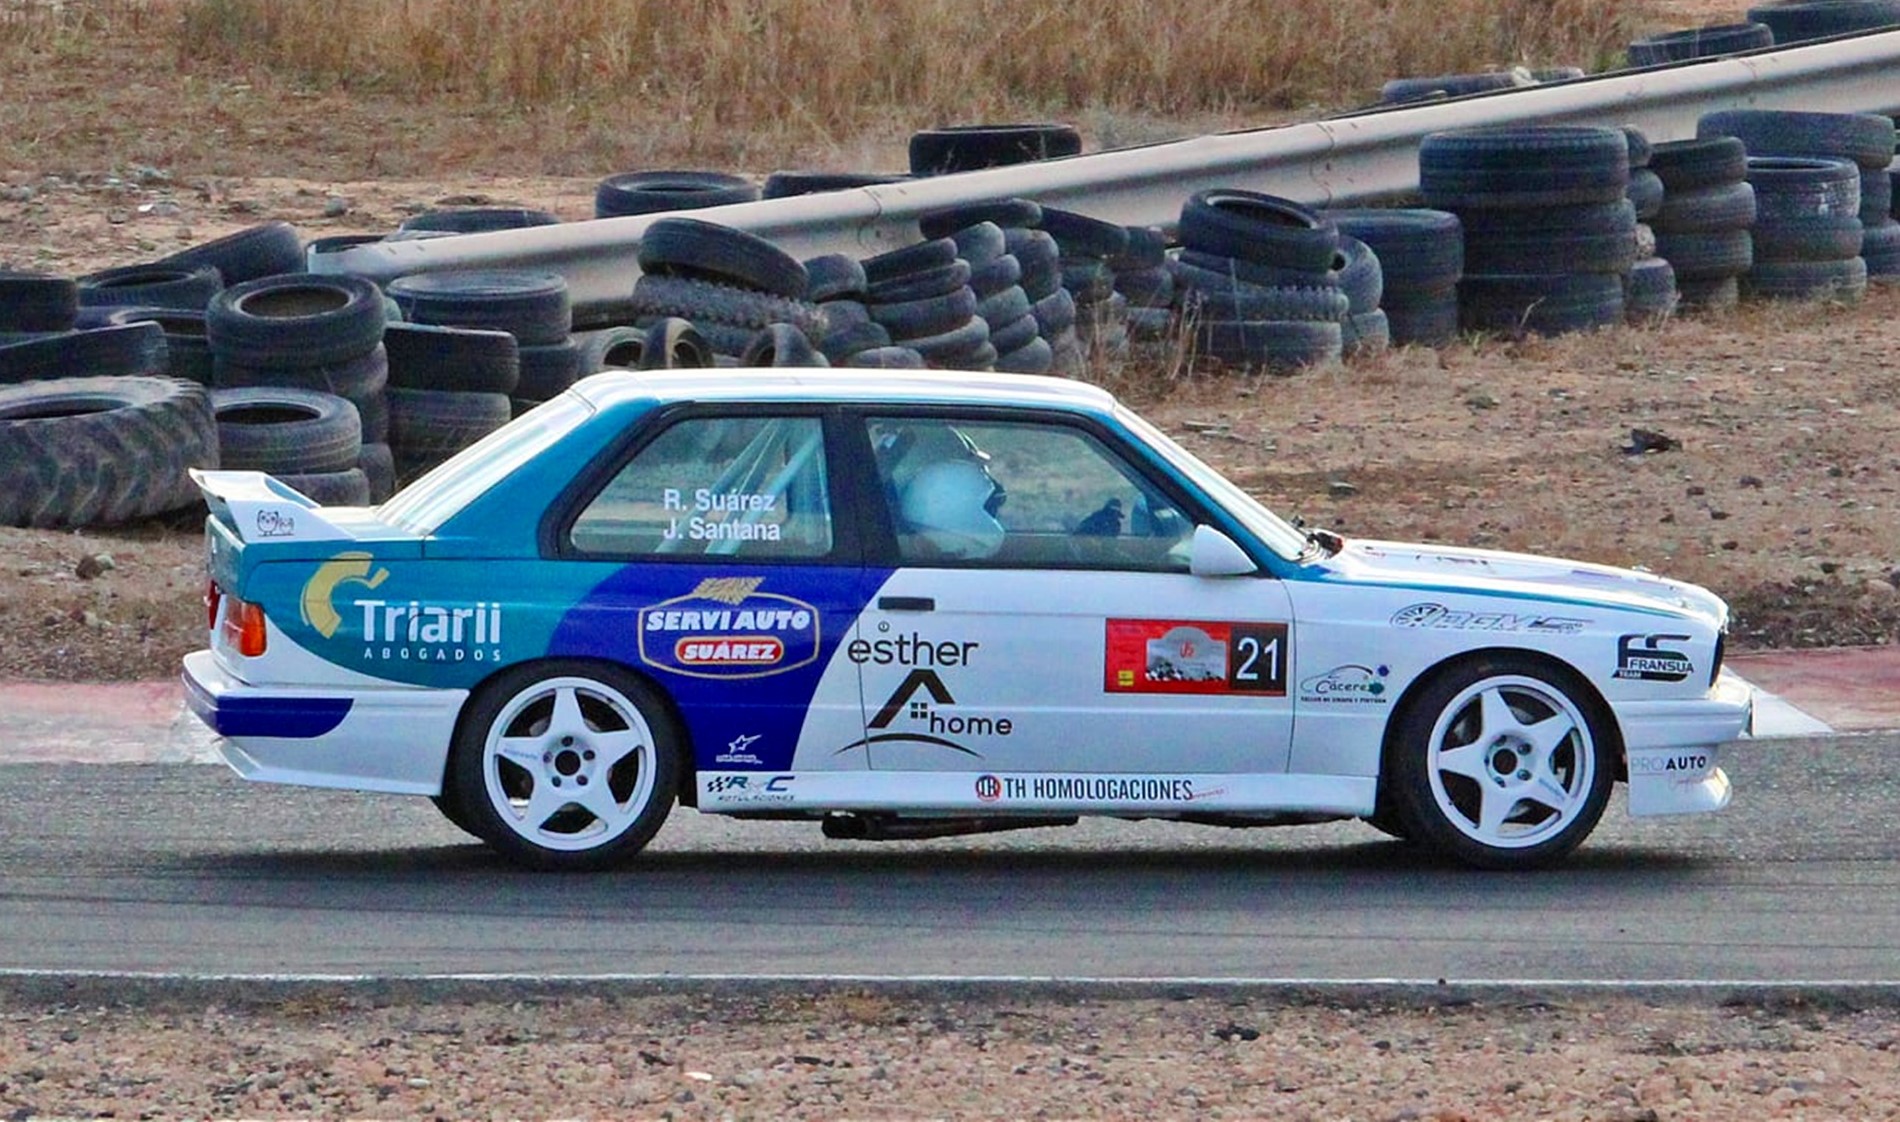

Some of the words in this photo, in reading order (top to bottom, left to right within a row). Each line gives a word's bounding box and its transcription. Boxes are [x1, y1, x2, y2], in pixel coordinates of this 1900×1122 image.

[664, 488, 687, 511] R.
[695, 488, 776, 511] Suárez
[663, 518, 683, 539] J.
[689, 517, 780, 540] Santana
[354, 600, 500, 643] Triarii
[646, 611, 731, 630] SERVI
[732, 610, 810, 630] AUTO
[364, 648, 500, 661] ABOGADOS
[683, 642, 777, 659] SUÁREZ
[847, 632, 979, 666] esther
[1236, 637, 1278, 680] 21
[1630, 659, 1694, 673] FRANSUA
[930, 711, 1013, 735] home
[1005, 778, 1026, 798] TH
[1034, 778, 1193, 800] HOMOLOGACIONES
